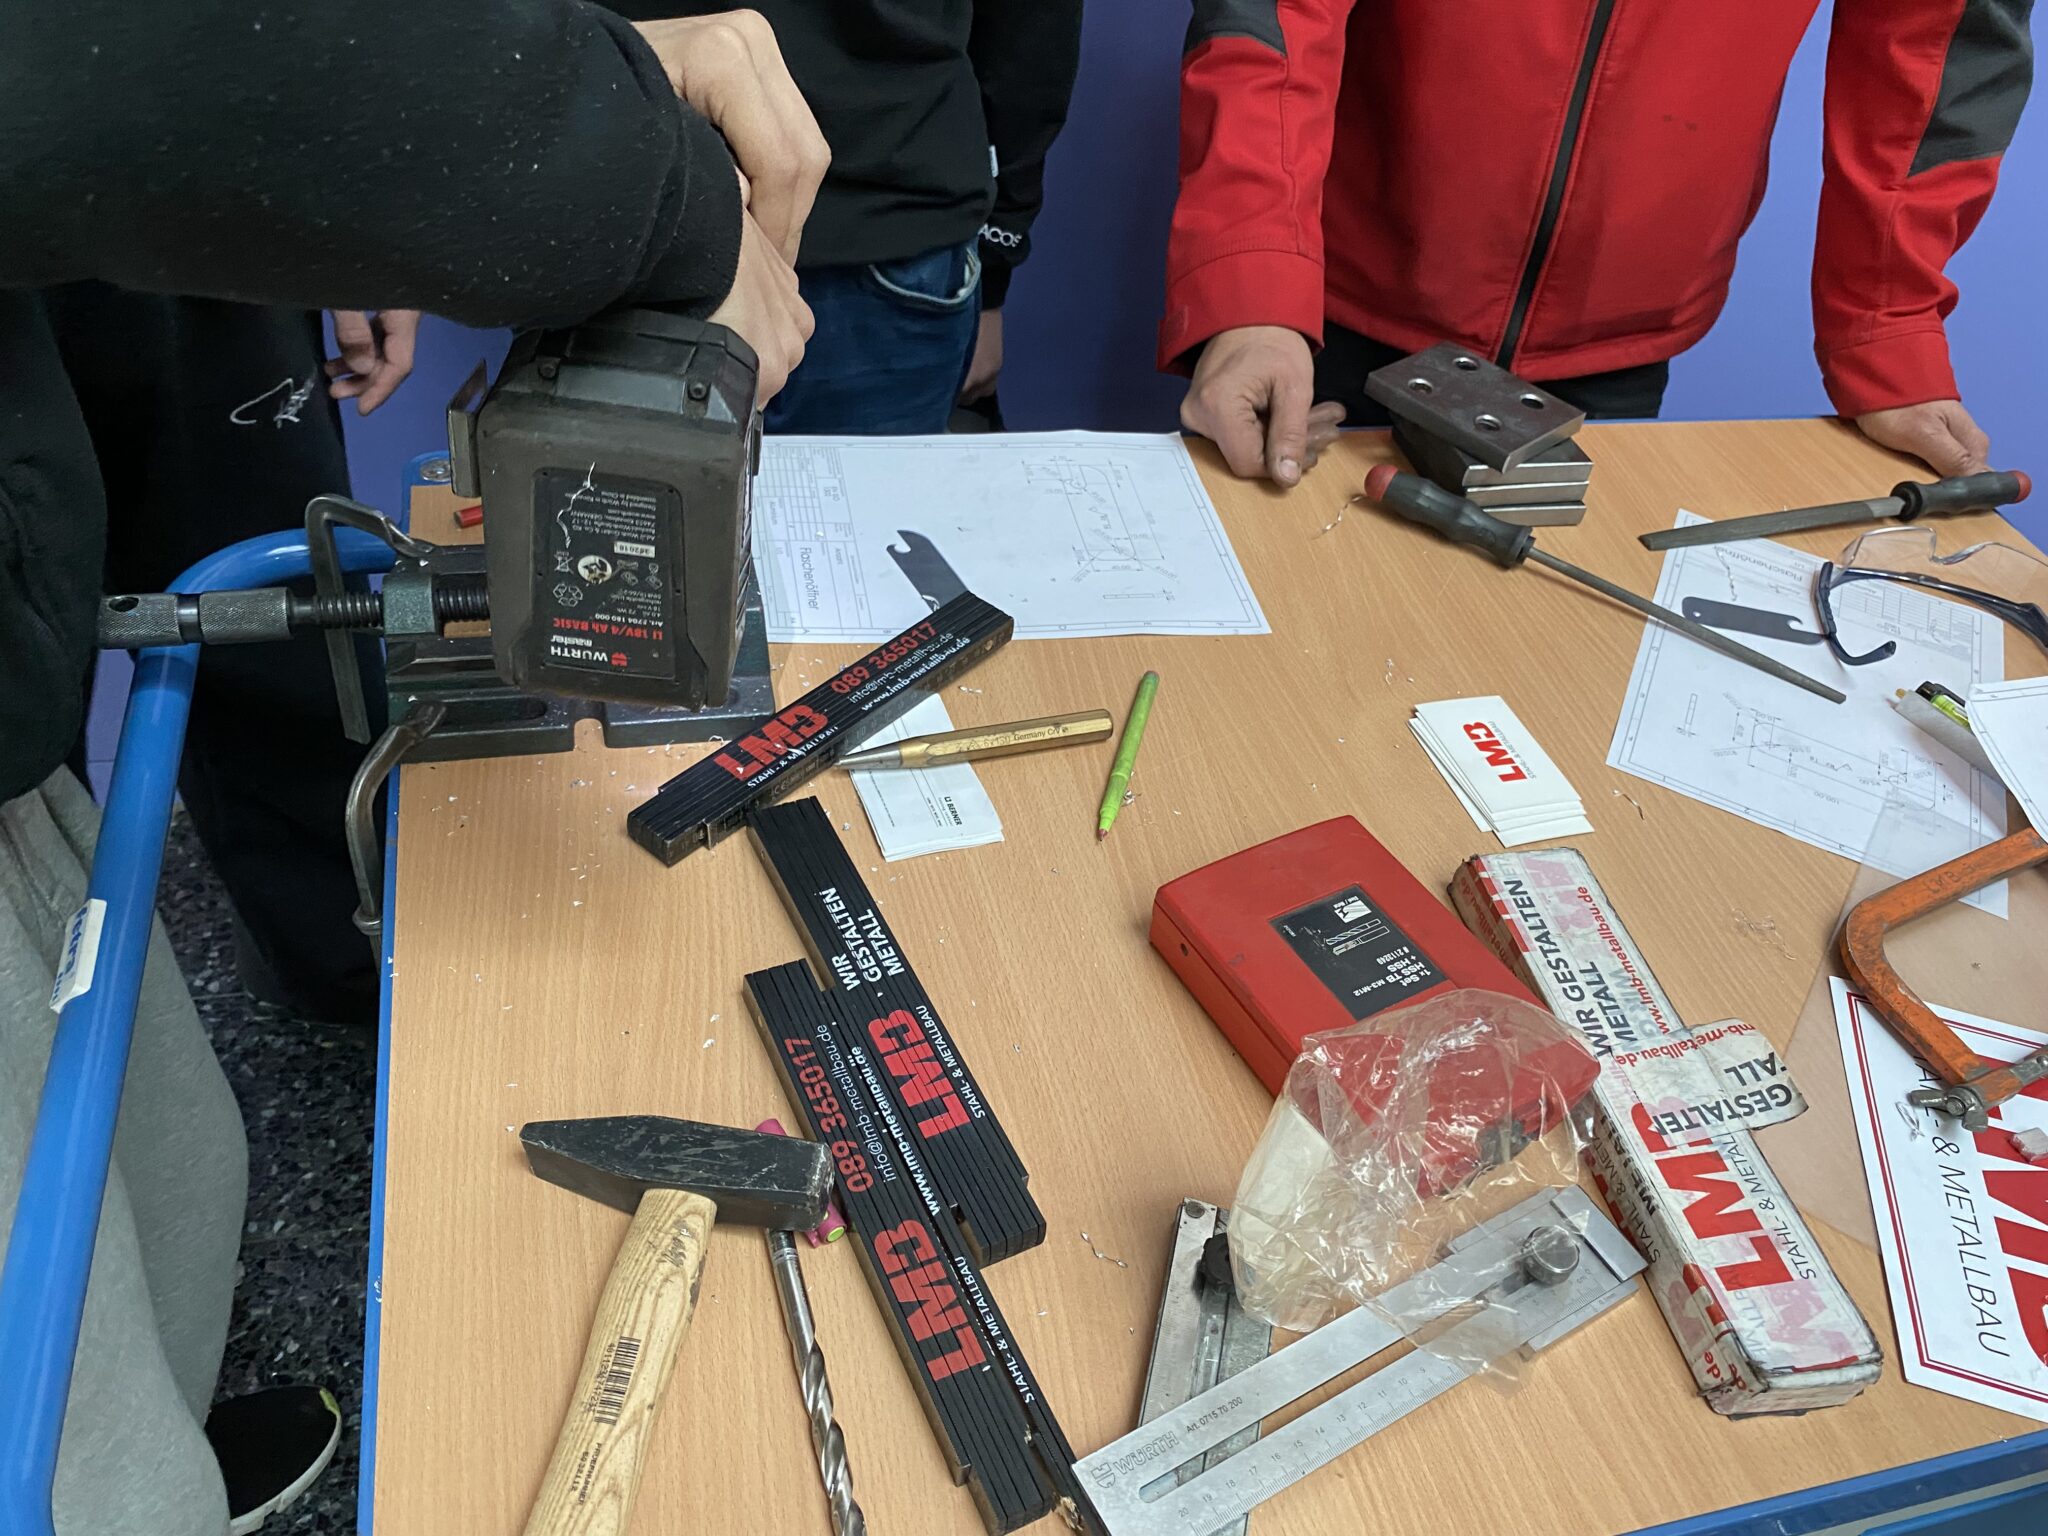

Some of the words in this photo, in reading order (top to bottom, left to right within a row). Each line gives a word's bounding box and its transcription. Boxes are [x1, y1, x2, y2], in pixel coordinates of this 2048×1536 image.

[799, 545, 821, 610] Flaschenöffner
[549, 634, 592, 648] master
[551, 617, 589, 631] BASIC
[590, 622, 608, 634] Ah
[648, 619, 663, 627] Art.
[828, 661, 872, 698] 089
[866, 618, 938, 674] 365017
[1012, 729, 1046, 742] Germany
[946, 802, 962, 826] BERNER
[817, 883, 884, 986] GESTALTEN
[855, 906, 905, 978] METALL
[1503, 876, 1587, 1006] GESTALTEN
[830, 950, 862, 991] WIR
[1384, 970, 1403, 984] TB
[1385, 956, 1411, 973] HSS
[1398, 972, 1420, 987] Set
[1399, 960, 1425, 977] HSS
[1418, 967, 1431, 978] 1x
[1351, 977, 1386, 997] M3-M12
[914, 1002, 958, 1070] METALLBAU
[1574, 1006, 1614, 1058] WIR
[783, 1037, 848, 1136] 365017
[949, 1066, 964, 1080] &
[1723, 1049, 1787, 1091] ALL
[808, 1021, 901, 1185] info@lmb-metallbau.de
[955, 1076, 986, 1121] STAHL-
[829, 1134, 875, 1196] 089
[1931, 1129, 1961, 1160] &
[1756, 1196, 1775, 1214] &
[1620, 1196, 1663, 1263] STAHL-
[1770, 1213, 1818, 1282] STAHL-
[1937, 1158, 2009, 1356] METALLBAU
[953, 1253, 1002, 1337] METALLBAU
[994, 1337, 1008, 1351] &
[1112, 1426, 1180, 1479] WÜRTH
[1185, 1420, 1201, 1435] Art.
[1198, 1409, 1219, 1427] 0715
[1217, 1403, 1230, 1416] 70
[1226, 1395, 1244, 1410] 200
[1177, 1506, 1190, 1519] 20
[1201, 1492, 1214, 1504] 19
[1224, 1478, 1237, 1490] 18
[1247, 1464, 1259, 1476] 17
[1270, 1451, 1282, 1463] 16
[1292, 1438, 1304, 1450] 15
[1314, 1425, 1326, 1437] 14
[1335, 1413, 1347, 1424] 13
[1356, 1400, 1368, 1412] 12
[1377, 1388, 1388, 1399] 11
[1396, 1375, 1409, 1387] 10
